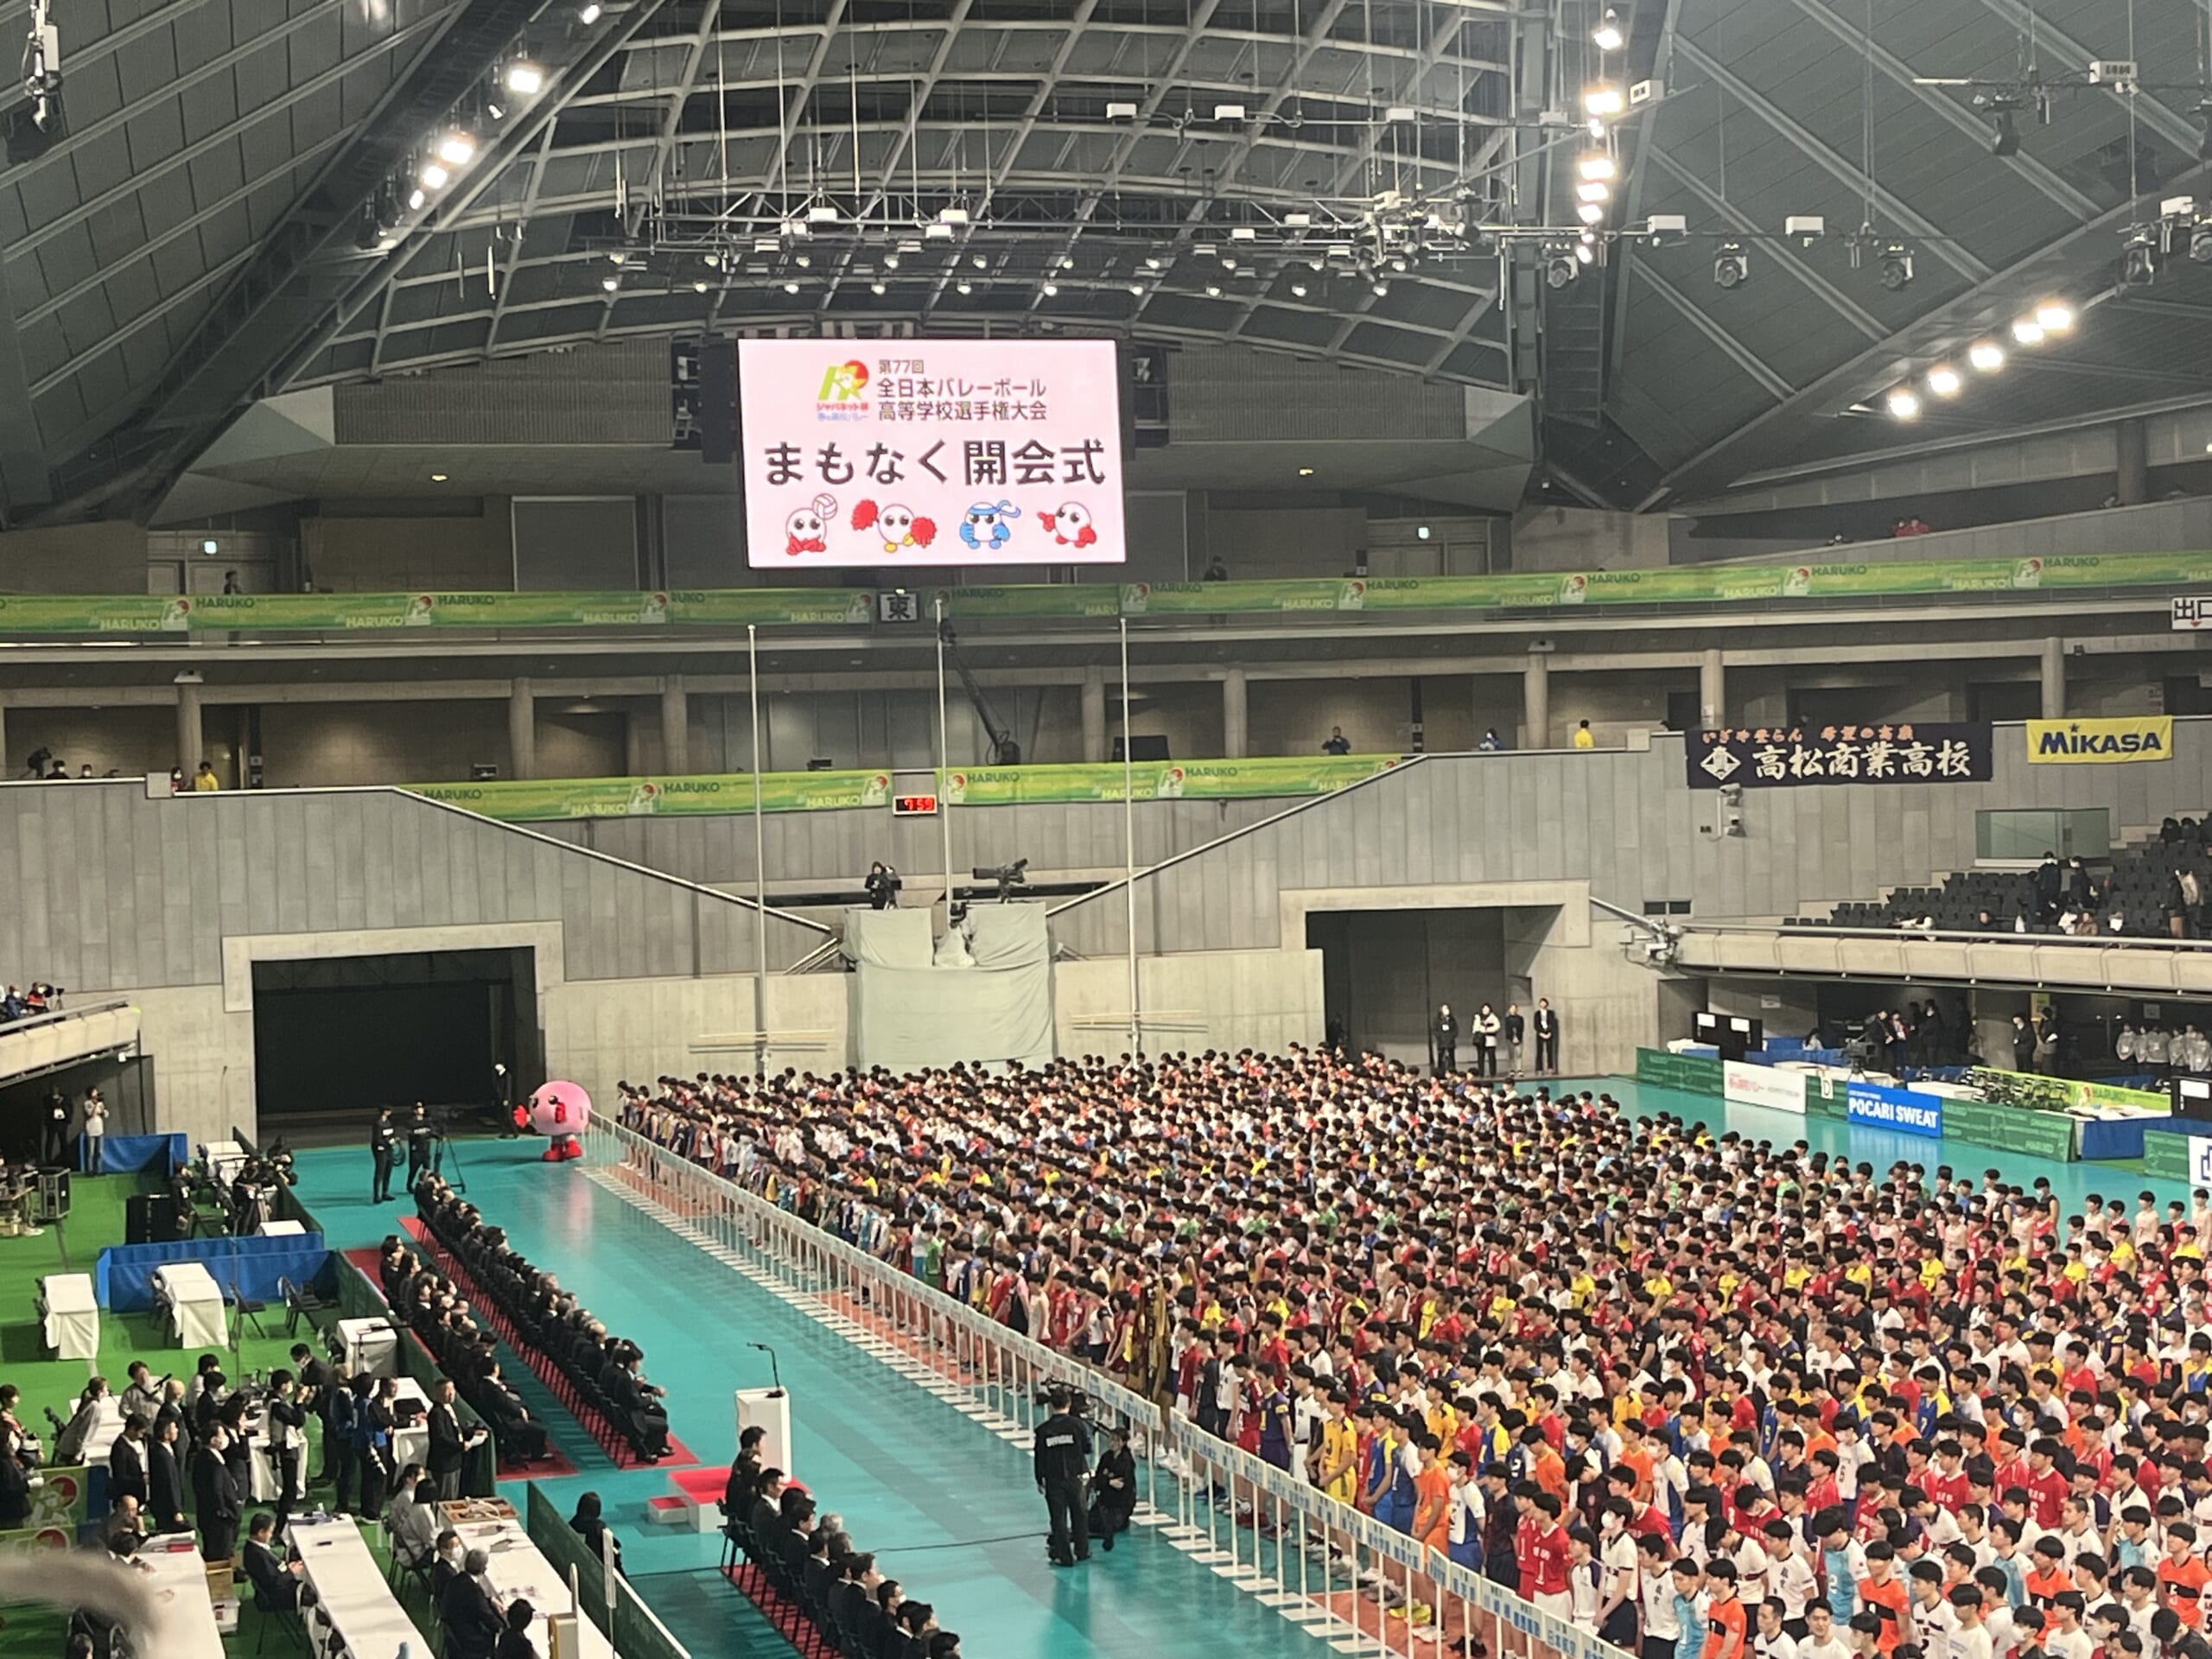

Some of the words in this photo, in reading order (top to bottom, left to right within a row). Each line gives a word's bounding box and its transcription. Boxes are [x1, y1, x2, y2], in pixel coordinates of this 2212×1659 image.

[878, 359, 925, 374] 第77回
[877, 378, 1047, 398] 全日本バレーボール
[878, 401, 1047, 422] 高等学校選手権大会
[764, 438, 1106, 486] まもなく開会式
[2044, 556, 2100, 568] HARUKO
[1811, 565, 1867, 575] HARUKO
[1587, 573, 1641, 583] HARUKO
[1367, 580, 1419, 590] HARUKO
[196, 597, 255, 608] HARUKO
[438, 594, 495, 606] HARUKO
[887, 594, 911, 620] 東
[346, 615, 404, 628] HARUKO
[1752, 740, 1971, 779] 高松商業高校
[966, 772, 1020, 783] HARUKO
[1185, 766, 1238, 778] HARUKO
[664, 782, 720, 793] HARUKO
[806, 794, 861, 807] HARUKO
[571, 803, 627, 817] HARUKO
[1848, 1097, 1894, 1121] POCARI
[1896, 1103, 1938, 1128] SWEAT
